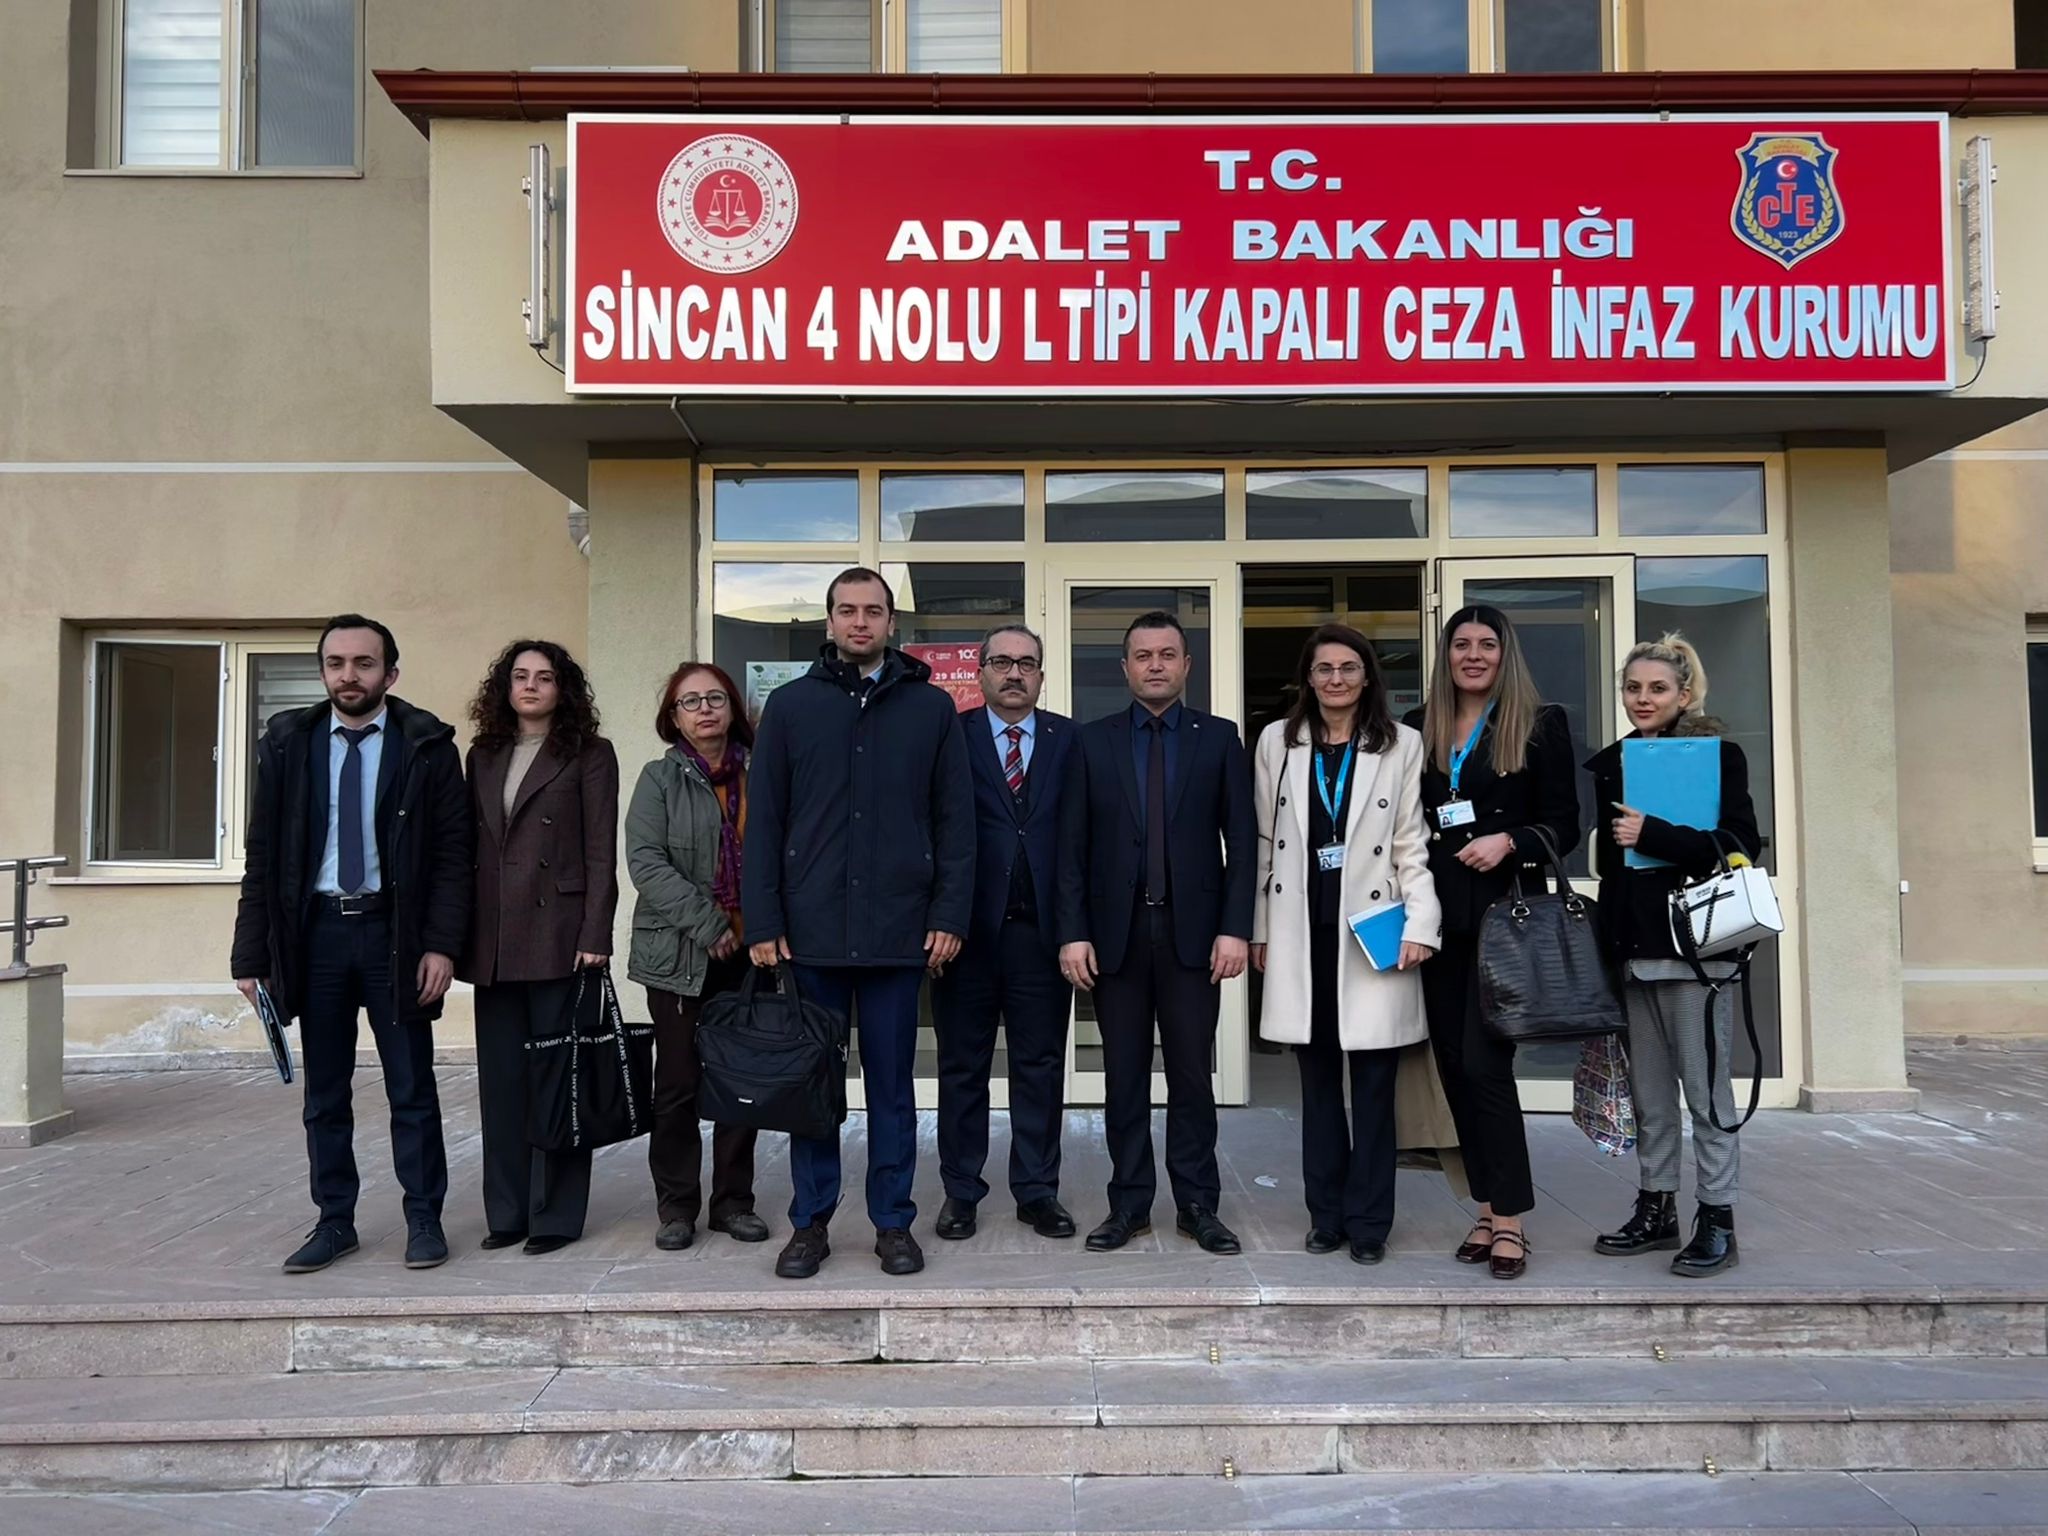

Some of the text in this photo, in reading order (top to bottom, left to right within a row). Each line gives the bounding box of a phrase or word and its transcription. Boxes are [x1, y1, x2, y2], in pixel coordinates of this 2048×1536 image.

[684, 160, 734, 202] CUMHURİYETİ
[736, 162, 767, 188] ADALET
[1204, 150, 1342, 190] T.C.
[886, 206, 1633, 262] ADALET BAKANLIĞI
[1777, 230, 1799, 239] 1923
[582, 268, 1938, 362] SİNCAN 4 NOLU L TİPİ KAPALI CEZA İNFAZ KURUMU
[934, 669, 976, 680] 29 EKİM
[610, 1005, 623, 1035] TOMMY
[616, 1036, 627, 1061] JEANS
[621, 1063, 633, 1094] TOMMY
